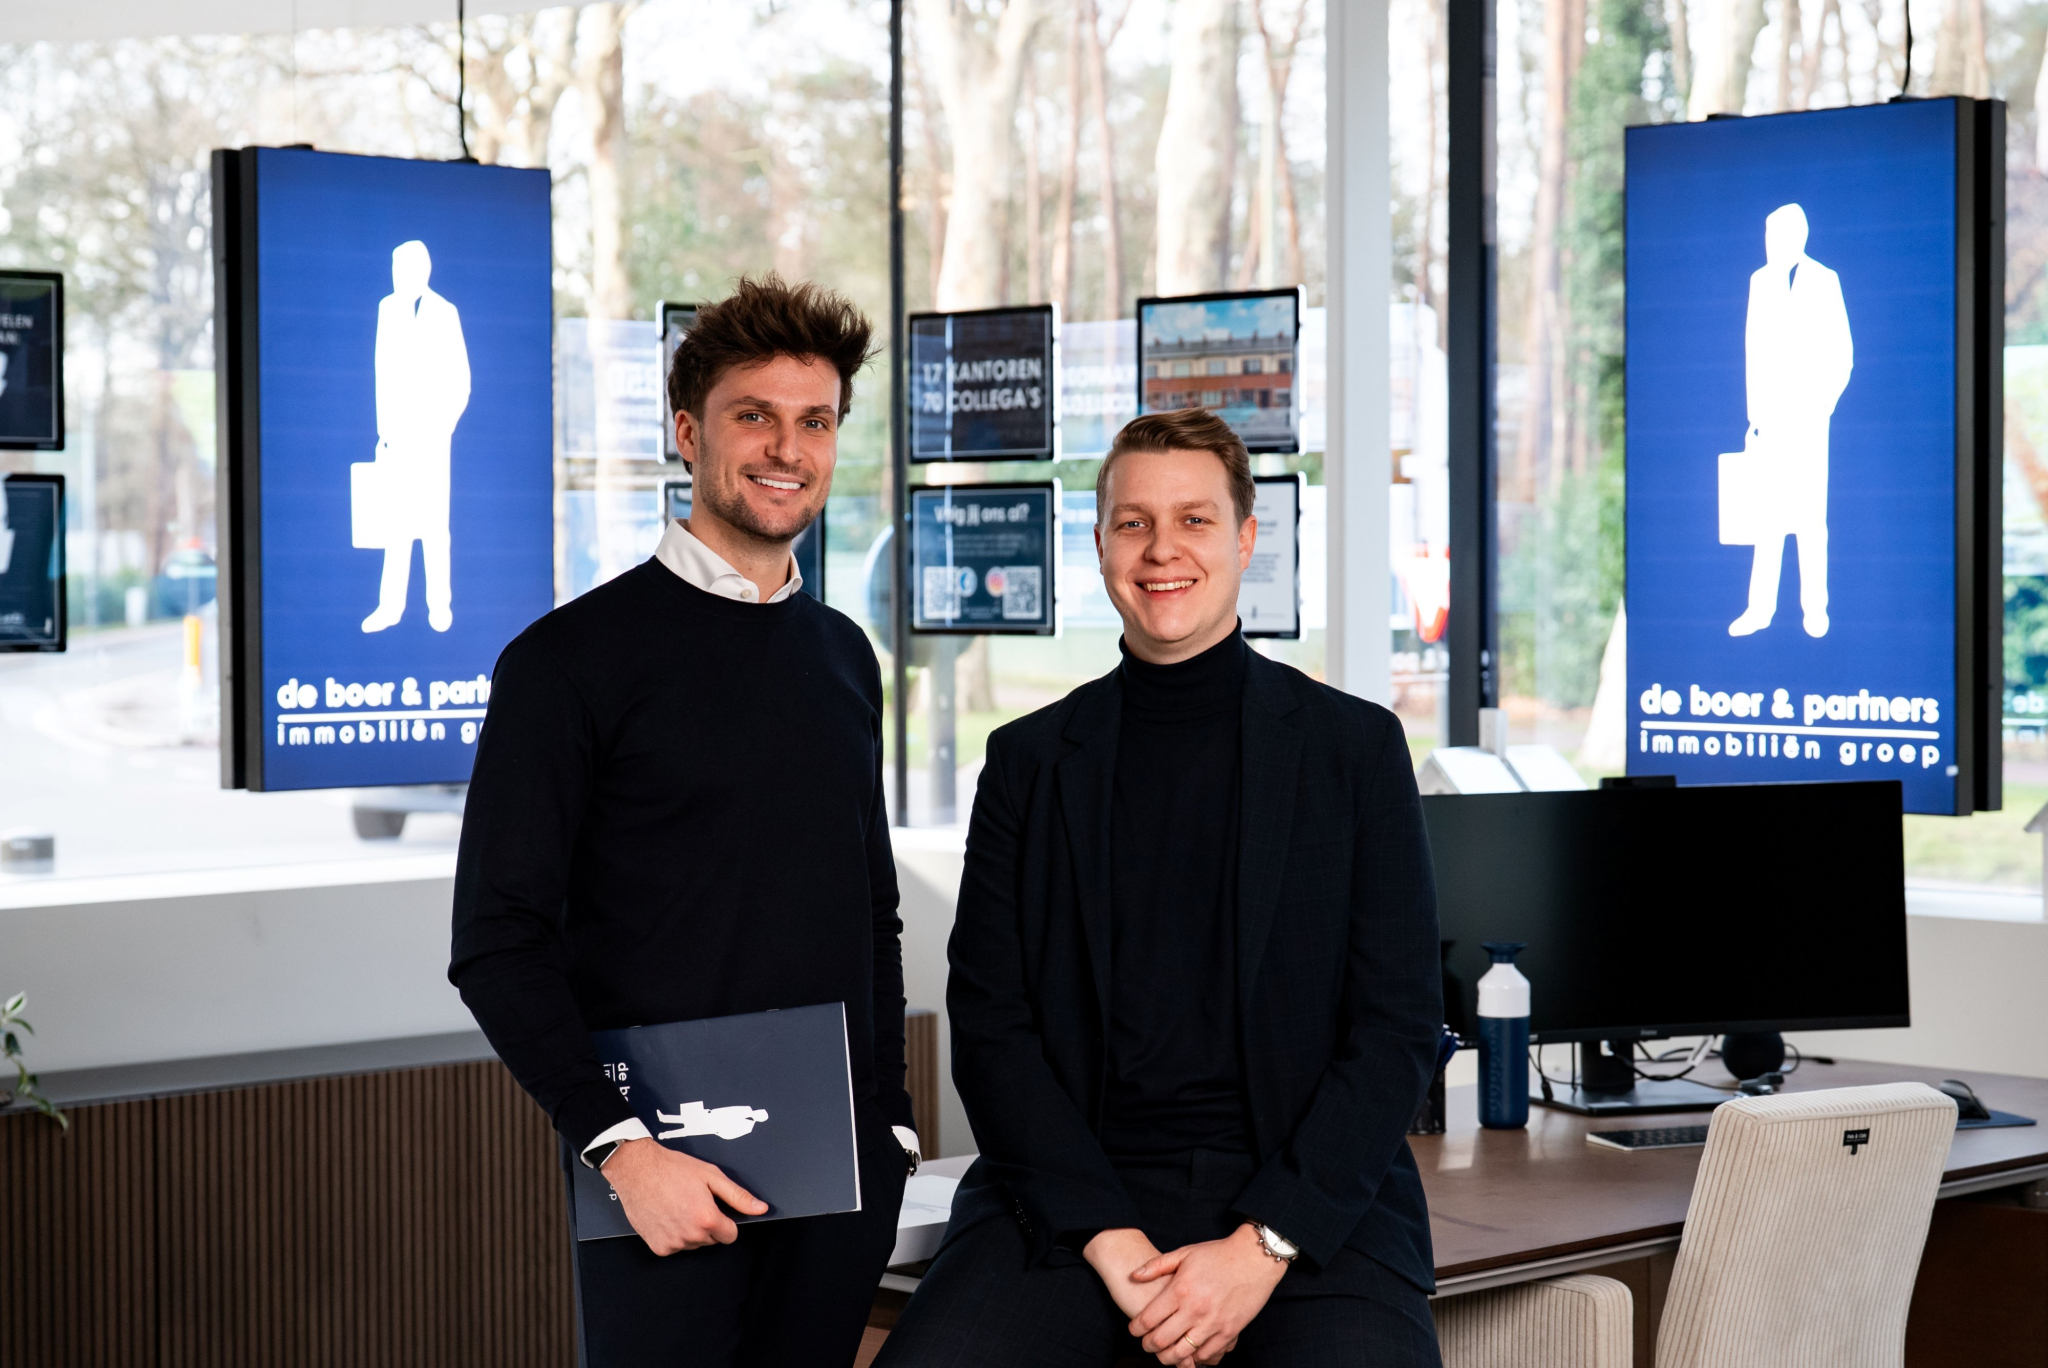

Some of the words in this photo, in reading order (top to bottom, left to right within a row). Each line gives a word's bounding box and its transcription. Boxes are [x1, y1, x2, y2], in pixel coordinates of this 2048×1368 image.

[922, 362, 944, 384] 17
[922, 391, 944, 414] 70
[277, 678, 319, 709] de
[325, 677, 395, 708] boer
[401, 677, 422, 706] &
[1640, 683, 1682, 716] de
[1690, 684, 1764, 718] boer
[1771, 688, 1794, 719] &
[1804, 689, 1940, 726] partners
[1640, 730, 1821, 759] immobiliën
[1839, 741, 1940, 769] groep
[617, 1062, 630, 1082] de
